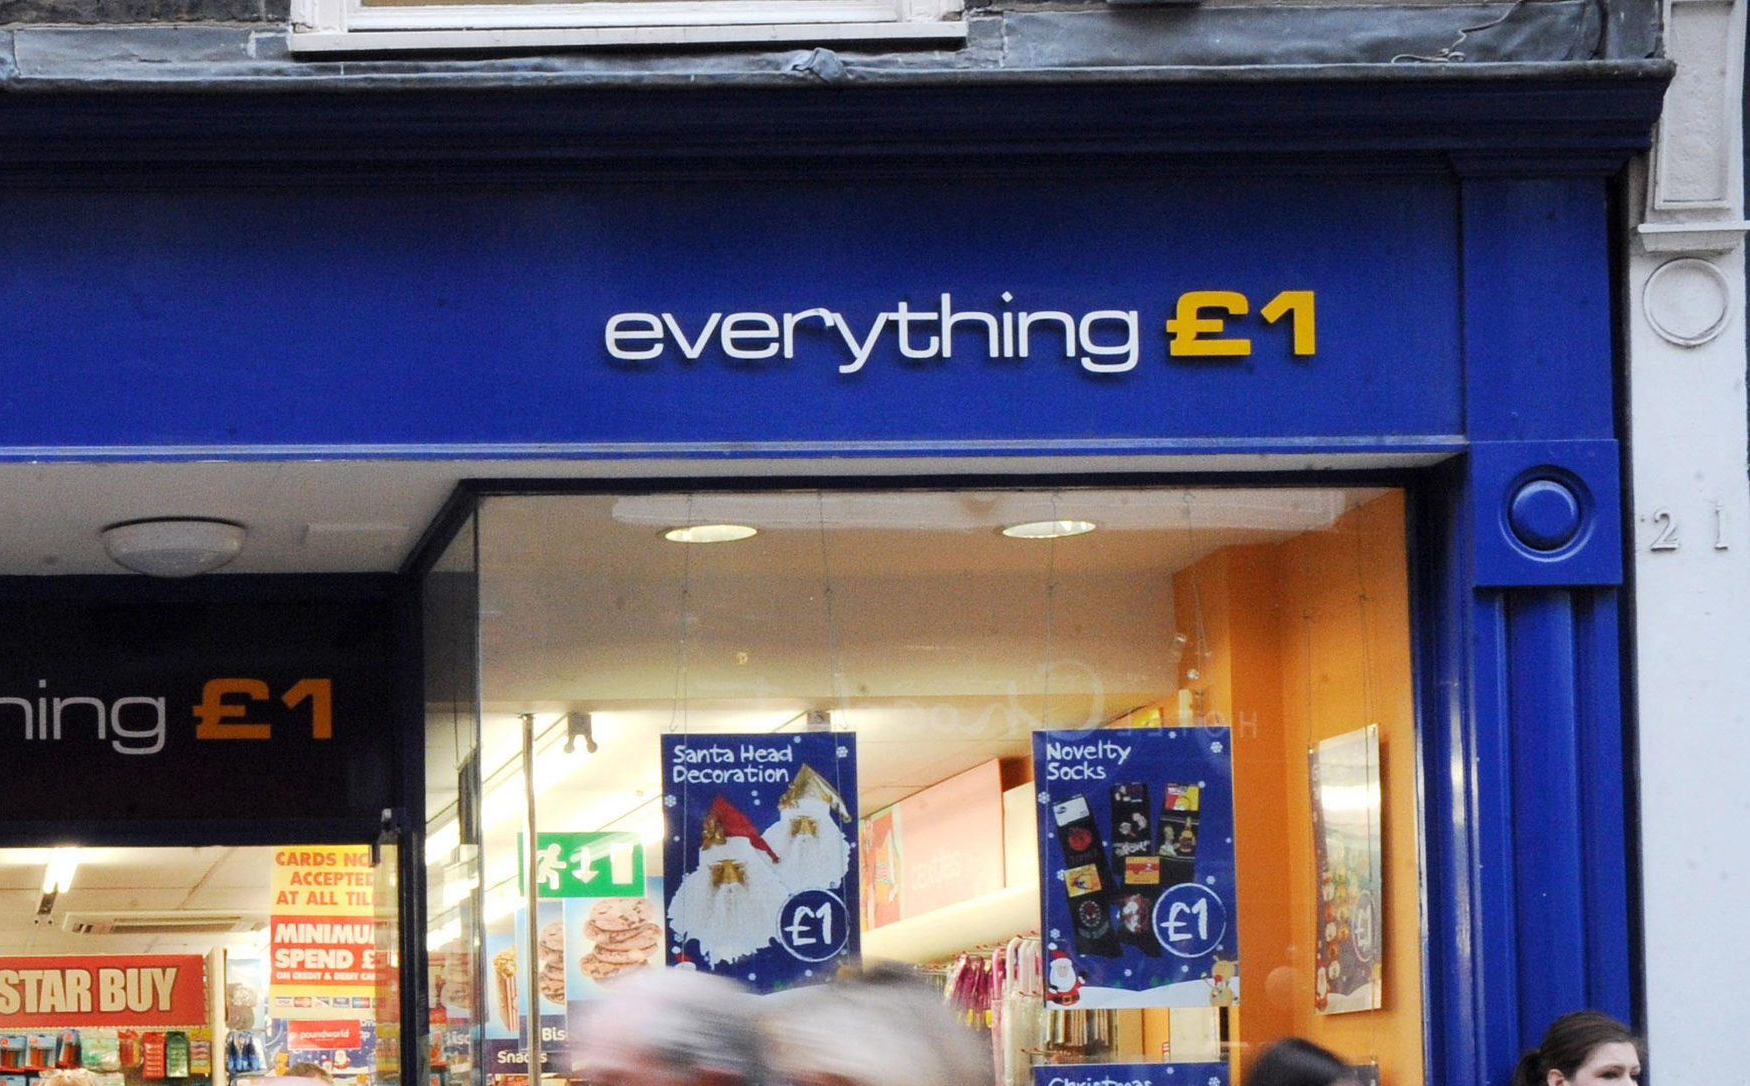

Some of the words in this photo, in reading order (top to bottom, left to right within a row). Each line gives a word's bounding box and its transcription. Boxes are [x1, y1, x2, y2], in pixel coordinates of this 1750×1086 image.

[605, 291, 1139, 373] everything
[1166, 290, 1316, 356] £1
[193, 678, 333, 739] £1
[673, 744, 735, 763] Santa
[740, 744, 793, 763] Head
[1047, 741, 1131, 766] Novelty
[672, 764, 790, 784] Decoration
[1047, 762, 1107, 780] Socks
[275, 851, 337, 867] CARDS
[343, 852, 374, 868] NO
[276, 891, 299, 906] AT
[306, 891, 339, 906] ALL
[785, 902, 833, 948] £1
[1160, 898, 1208, 941] £1
[275, 948, 354, 969] SPEND
[99, 967, 178, 1012] BUY
[541, 1027, 568, 1042] Bis
[497, 1050, 548, 1064] Snacs
